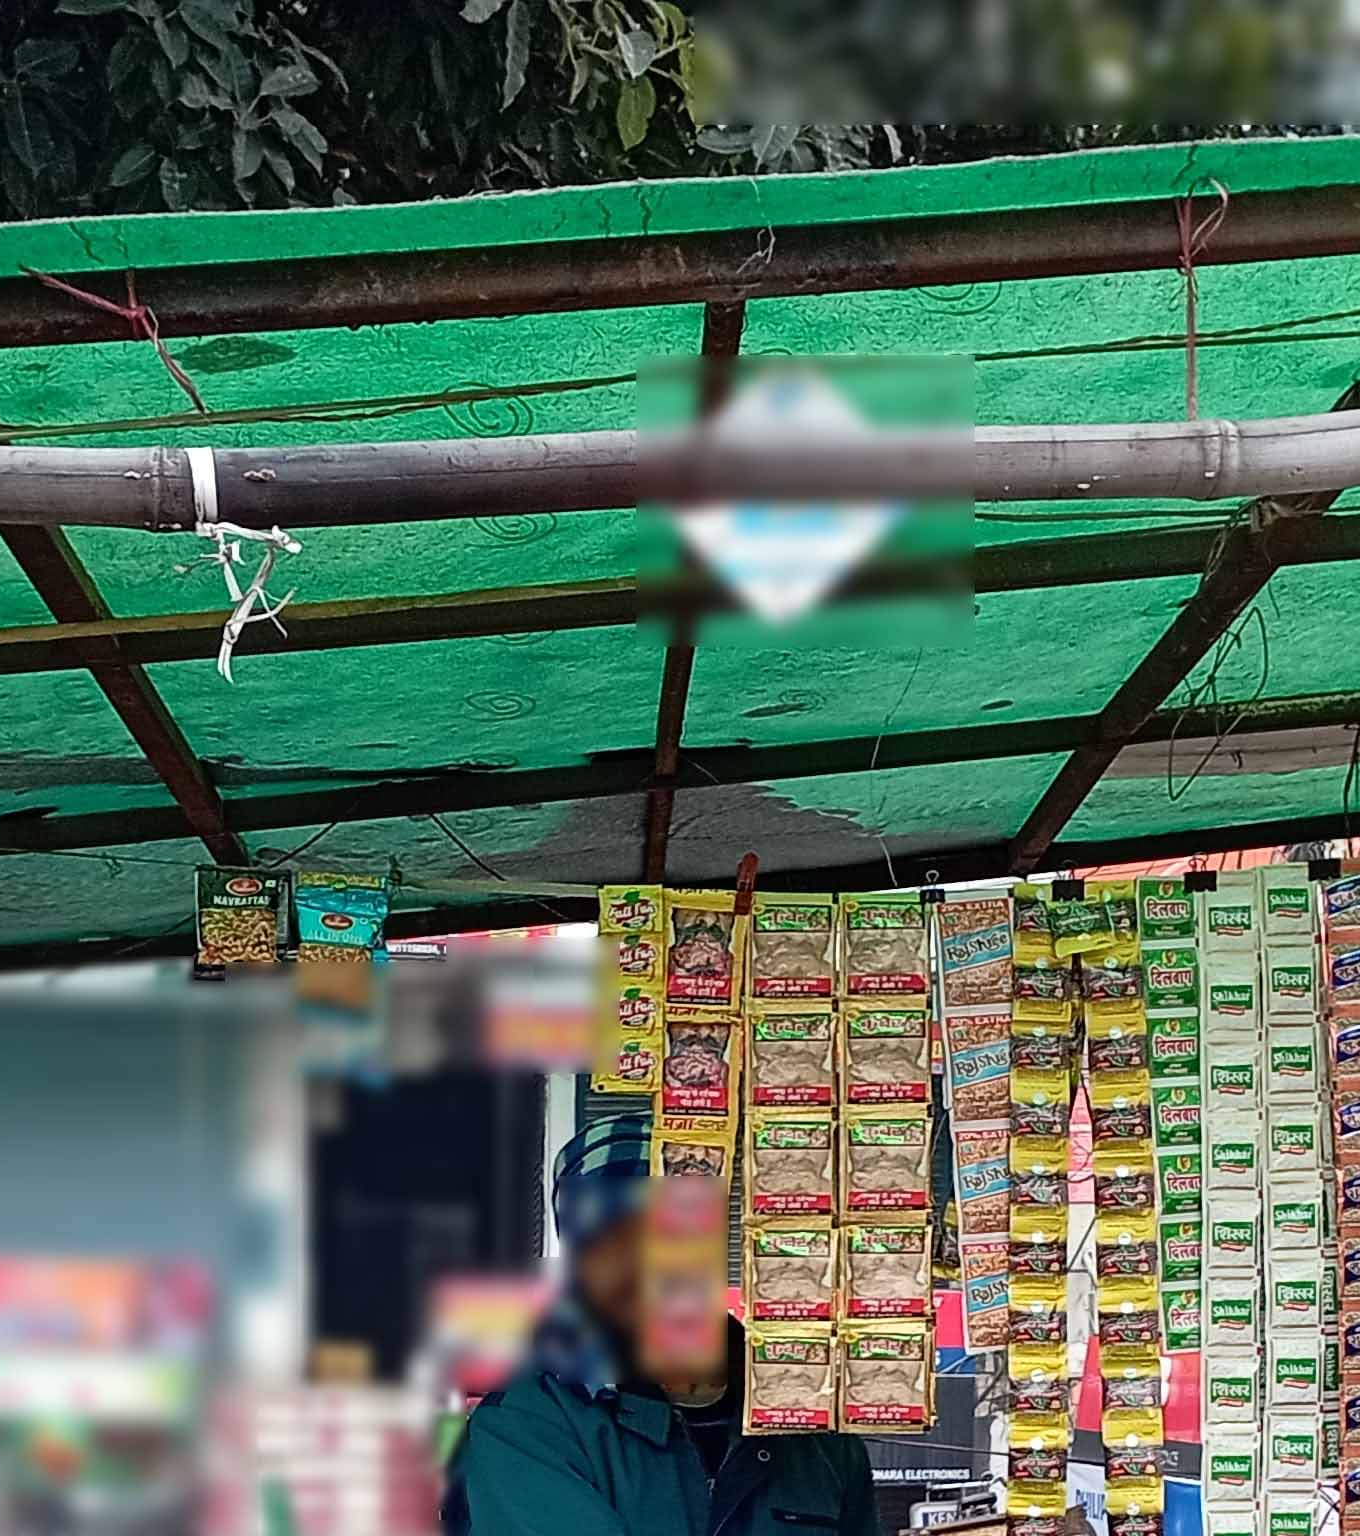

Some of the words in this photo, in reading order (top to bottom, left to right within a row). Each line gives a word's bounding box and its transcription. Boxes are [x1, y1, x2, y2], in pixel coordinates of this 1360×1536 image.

[1270, 893, 1307, 906] Shikhar
[1211, 911, 1250, 926] शिखर
[1274, 972, 1309, 986] शिखर
[1212, 989, 1251, 1002] Shikhar
[1272, 1051, 1311, 1065] Shikhar
[1213, 1069, 1251, 1084] शिखर
[1273, 1130, 1311, 1145] शिखर
[1214, 1148, 1252, 1162] Shikhar
[1275, 1206, 1314, 1221] Shikhar
[1215, 1226, 1252, 1241] शिखर
[1277, 1286, 1315, 1300] शिखर
[1212, 1304, 1250, 1317] Shikhar
[1278, 1363, 1315, 1377] Shikhar
[1211, 1383, 1250, 1397] शिखर
[1274, 1439, 1312, 1455] शिखर
[1212, 1460, 1250, 1473] Shikhar
[1271, 1516, 1310, 1529] Shikhar
